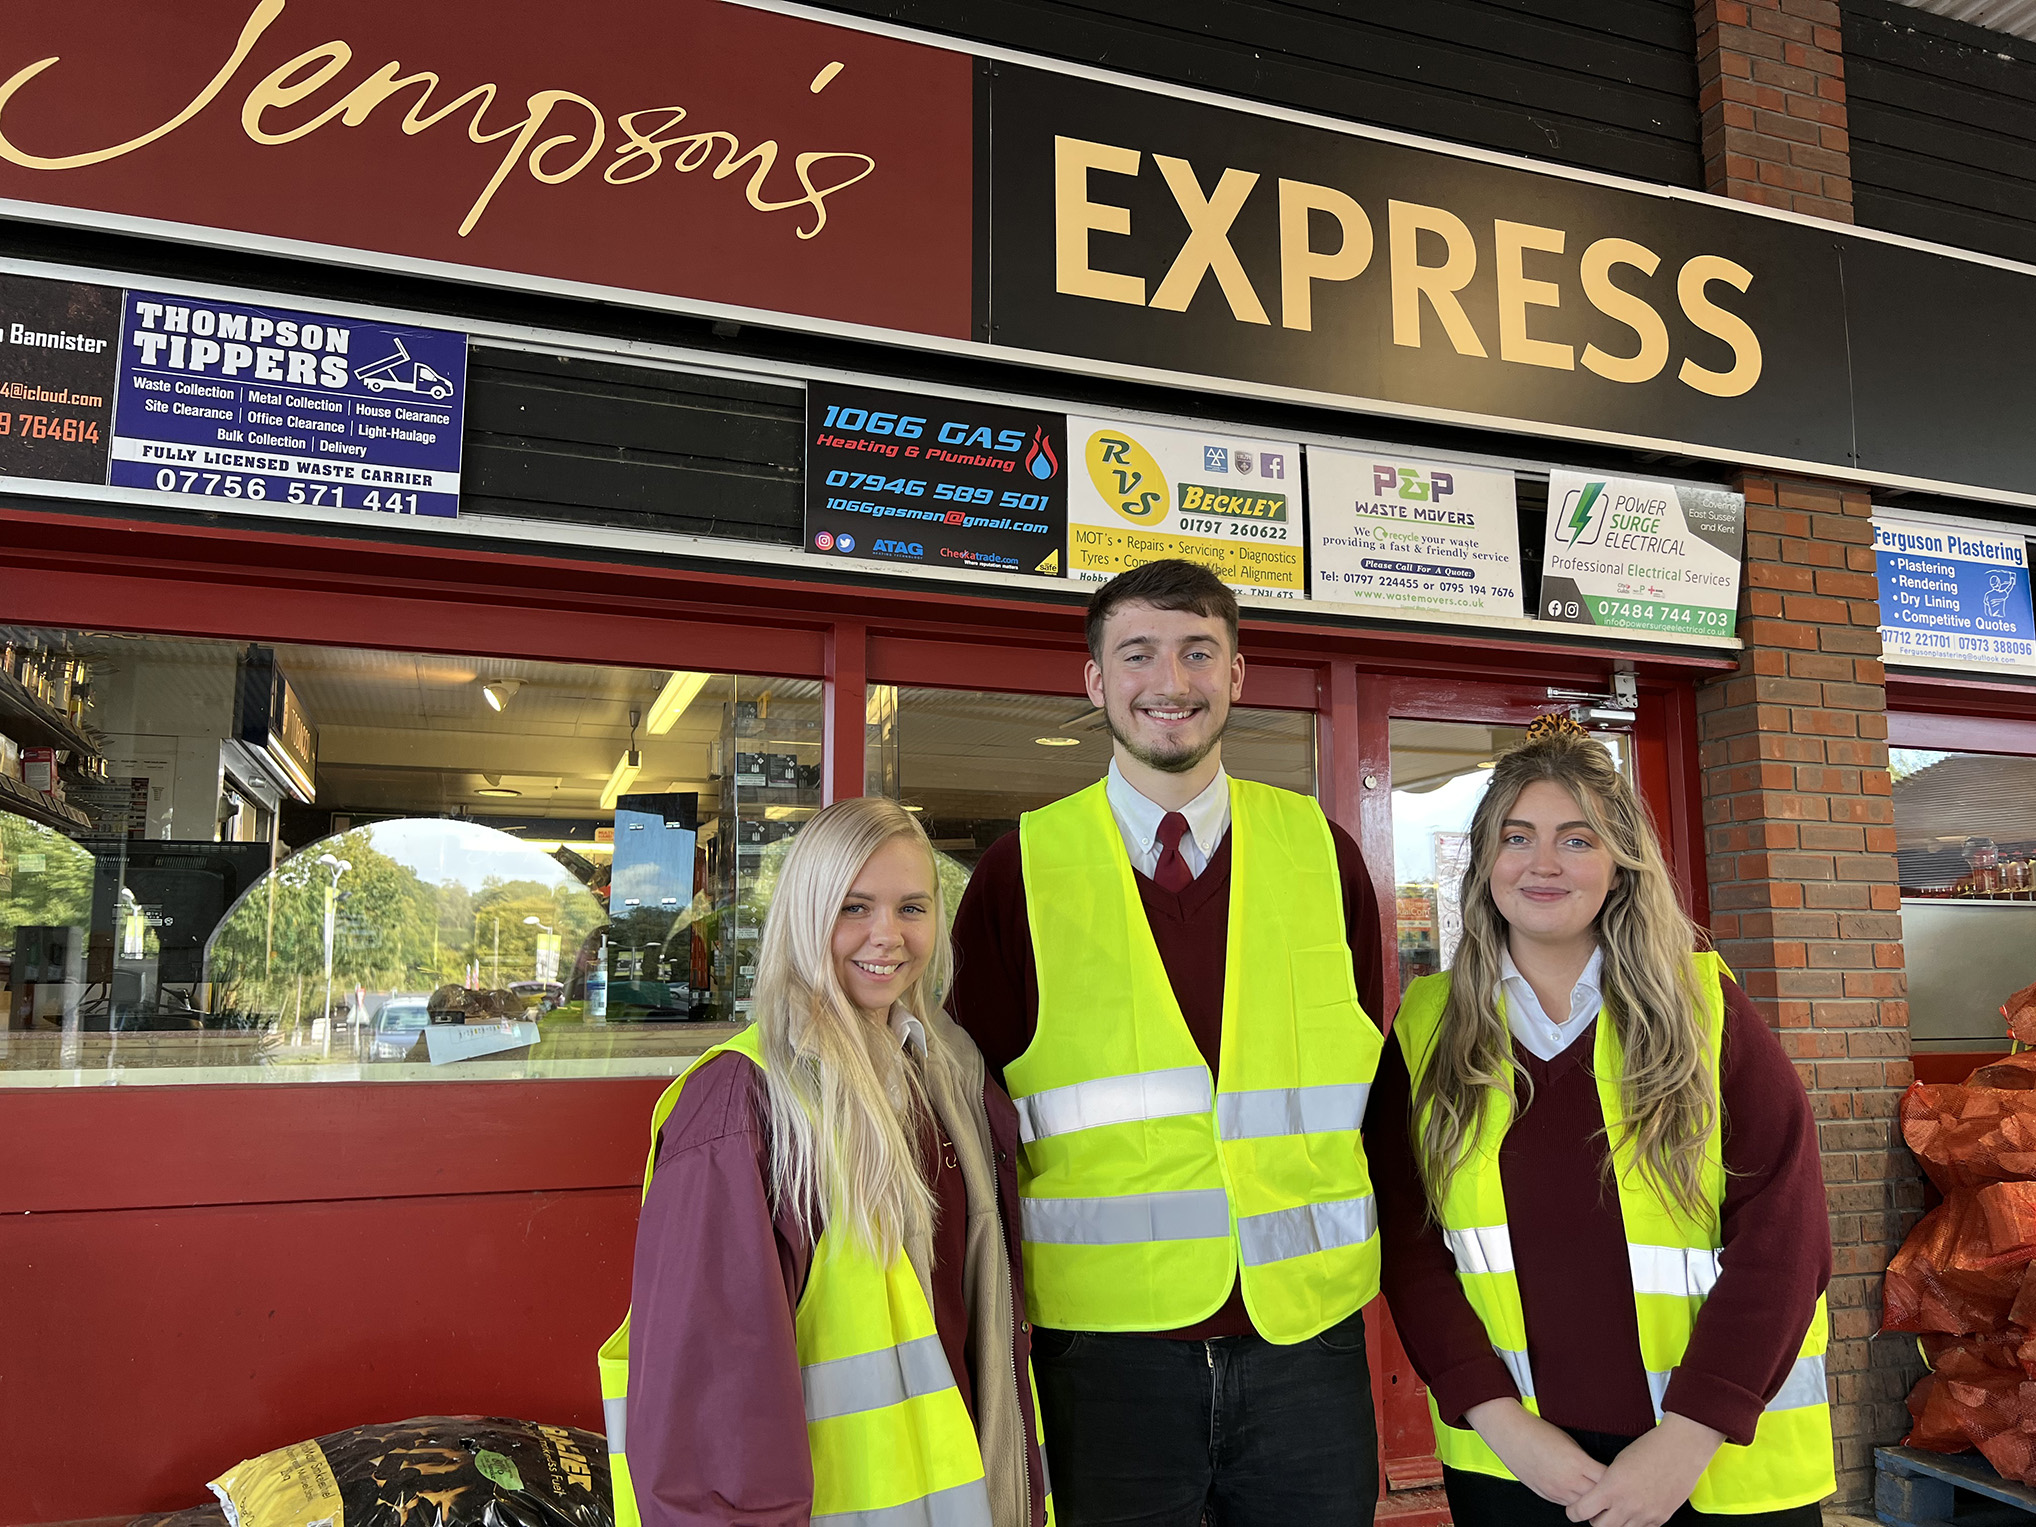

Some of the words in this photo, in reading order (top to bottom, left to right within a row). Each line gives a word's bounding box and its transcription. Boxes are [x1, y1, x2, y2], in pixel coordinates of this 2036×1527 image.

[0, 0, 875, 239] Jempson's
[1054, 134, 1762, 397] EXPRESS
[10, 323, 107, 354] Bannister
[136, 302, 350, 354] THOMPSON
[133, 331, 348, 388] TIPPERS
[133, 376, 171, 392] Waste
[175, 381, 235, 400] Collection
[145, 399, 169, 413] Site
[173, 402, 233, 420] Clearance
[249, 390, 282, 405] Metal
[285, 394, 343, 413] Collection
[248, 411, 283, 426] Office
[287, 415, 345, 433] Clearance
[356, 403, 391, 418] House
[395, 407, 450, 425] Clearance
[19, 414, 99, 444] 764614
[217, 428, 244, 442] Bulk
[248, 431, 306, 449] Collection
[358, 423, 437, 445] Light-Haulage
[823, 405, 927, 439] 1066
[938, 422, 1026, 452] GAS
[319, 439, 367, 458] Delivery
[816, 433, 899, 458] Heating
[904, 446, 920, 458] &
[925, 449, 1016, 473] Plumbing
[142, 445, 197, 462] FULLY
[204, 452, 289, 471] LICENSED
[297, 461, 354, 479] WASTE
[361, 468, 433, 487] CARRIER
[155, 468, 267, 500] 07756
[287, 481, 343, 508] 571
[362, 490, 418, 515] 441
[825, 469, 927, 497] 07946
[933, 483, 994, 505] 589
[999, 491, 1050, 512] 501
[1373, 464, 1454, 502] P&P
[1182, 486, 1284, 518] BECKLEY
[1355, 501, 1407, 518] WASTE
[1414, 507, 1475, 525] MOVERS
[1615, 495, 1667, 517] POWER
[1702, 498, 1737, 514] Covering
[826, 497, 1049, 534] 1066gasman@gmail.com
[1610, 514, 1660, 534] SURGE
[1689, 508, 1706, 519] East
[1708, 510, 1736, 522] Sussex
[1180, 518, 1222, 534] 01797
[1230, 523, 1287, 540] 260622
[1354, 526, 1371, 537] We
[1389, 532, 1419, 543] recycle
[1421, 536, 1446, 546] your
[1450, 537, 1480, 549] waste
[1700, 523, 1716, 531] and
[1717, 524, 1735, 534] Kent
[873, 539, 923, 556] ATAG
[1076, 530, 1113, 546] MOT's
[1127, 536, 1164, 552] Repairs
[1178, 541, 1225, 560] Servicing
[1239, 547, 1297, 565] Diagnostics
[1322, 535, 1376, 551] providing
[1390, 541, 1410, 553] fast
[1414, 544, 1422, 554] &
[1426, 545, 1469, 560] friendly
[1472, 551, 1509, 563] service
[1605, 532, 1686, 556] ELECTRICAL
[1874, 527, 1942, 552] Ferguson
[1947, 535, 2023, 565] Plastering
[940, 547, 1019, 565] Checkatrade.com
[1080, 549, 1109, 566] Tyres
[1080, 572, 1108, 582] Hobbs
[1240, 565, 1293, 582] Alignment
[1364, 560, 1393, 570] Please
[1395, 563, 1413, 572] Call
[1416, 565, 1431, 573] For
[1444, 568, 1472, 577] Quote:
[1552, 555, 1624, 575] Professional
[1627, 563, 1681, 581] Electrical
[1685, 570, 1731, 587] Services
[1897, 558, 1956, 578] Plastering
[1276, 591, 1294, 599] 6TS
[1320, 571, 1339, 582] Tel:
[1343, 573, 1374, 585] 01797
[1378, 576, 1419, 589] 224455
[1423, 582, 1435, 590] or
[1440, 583, 1464, 593] 0795
[1470, 585, 1487, 595] 194
[1491, 587, 1515, 598] 7676
[1899, 575, 1958, 595] Rendering
[1354, 589, 1484, 608] www.wastemovers.co.uk
[1900, 592, 1920, 608] Dry
[1925, 594, 1960, 612] Lining
[1598, 601, 1654, 619] 07484
[1660, 607, 1691, 623] 744
[1697, 611, 1728, 626] 703
[1902, 609, 1971, 628] Competitive
[1975, 616, 2017, 633] Quotes
[1604, 617, 1726, 635] info@powersurgeelectrical.co.uk
[1881, 629, 1911, 644] 07712
[1915, 632, 1951, 648] 221701
[1959, 637, 1989, 652] 07973
[1993, 640, 2032, 656] 388096
[1899, 646, 2016, 663] Fergusonplastering@outlookcom
